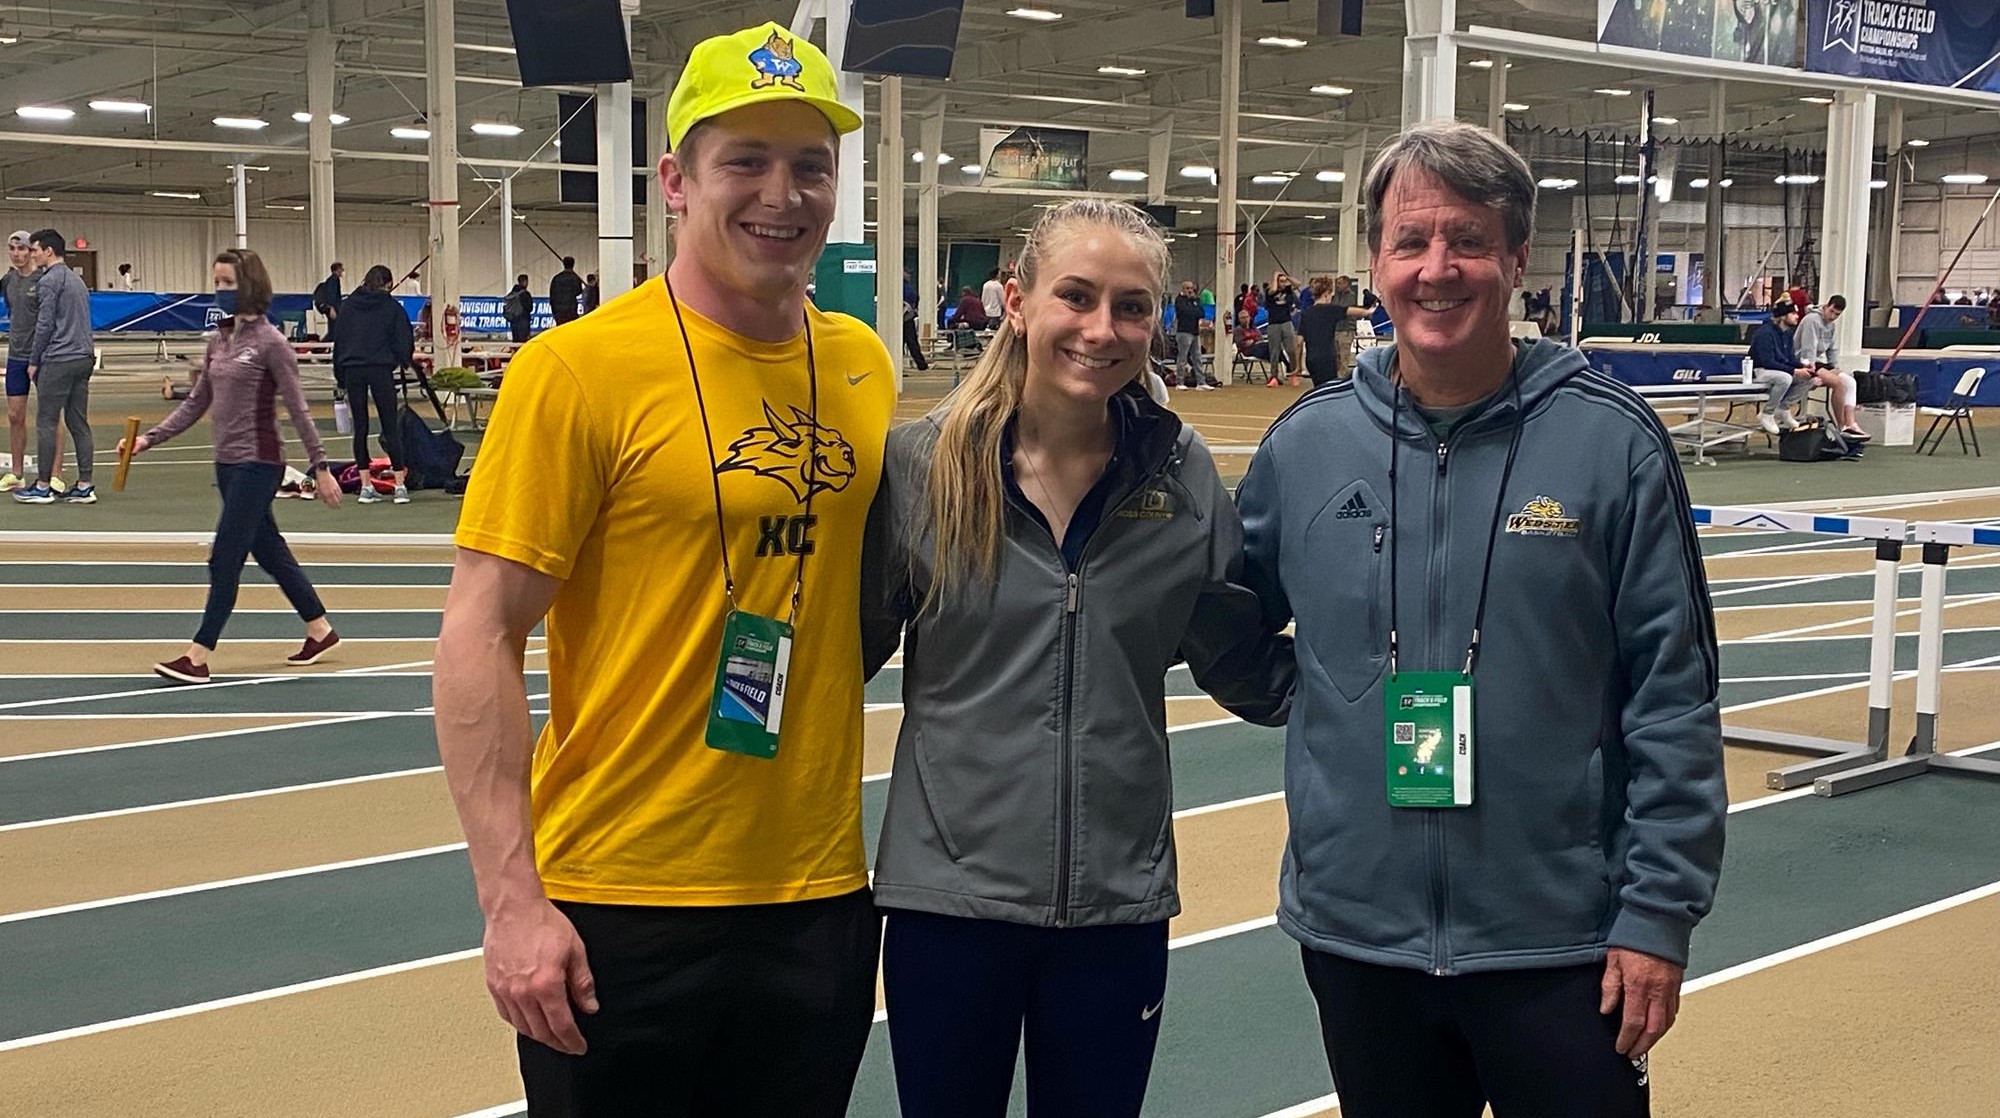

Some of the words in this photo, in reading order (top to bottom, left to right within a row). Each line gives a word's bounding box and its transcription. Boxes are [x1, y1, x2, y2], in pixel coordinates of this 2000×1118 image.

[1863, 0, 1898, 28] TRACK
[1897, 6, 1907, 29] &
[1906, 7, 1936, 33] FIELD
[1860, 26, 1919, 50] CHAMPIONSHIPS
[771, 59, 793, 72] W
[459, 302, 496, 314] DIVISION
[479, 316, 507, 328] TRACK
[1636, 333, 1661, 343] JDL
[1672, 369, 1702, 380] GILL
[1336, 509, 1372, 519] adidas
[755, 514, 818, 558] XC
[775, 673, 784, 696] COACH
[743, 685, 767, 703] FIELD
[1459, 733, 1467, 755] COACH
